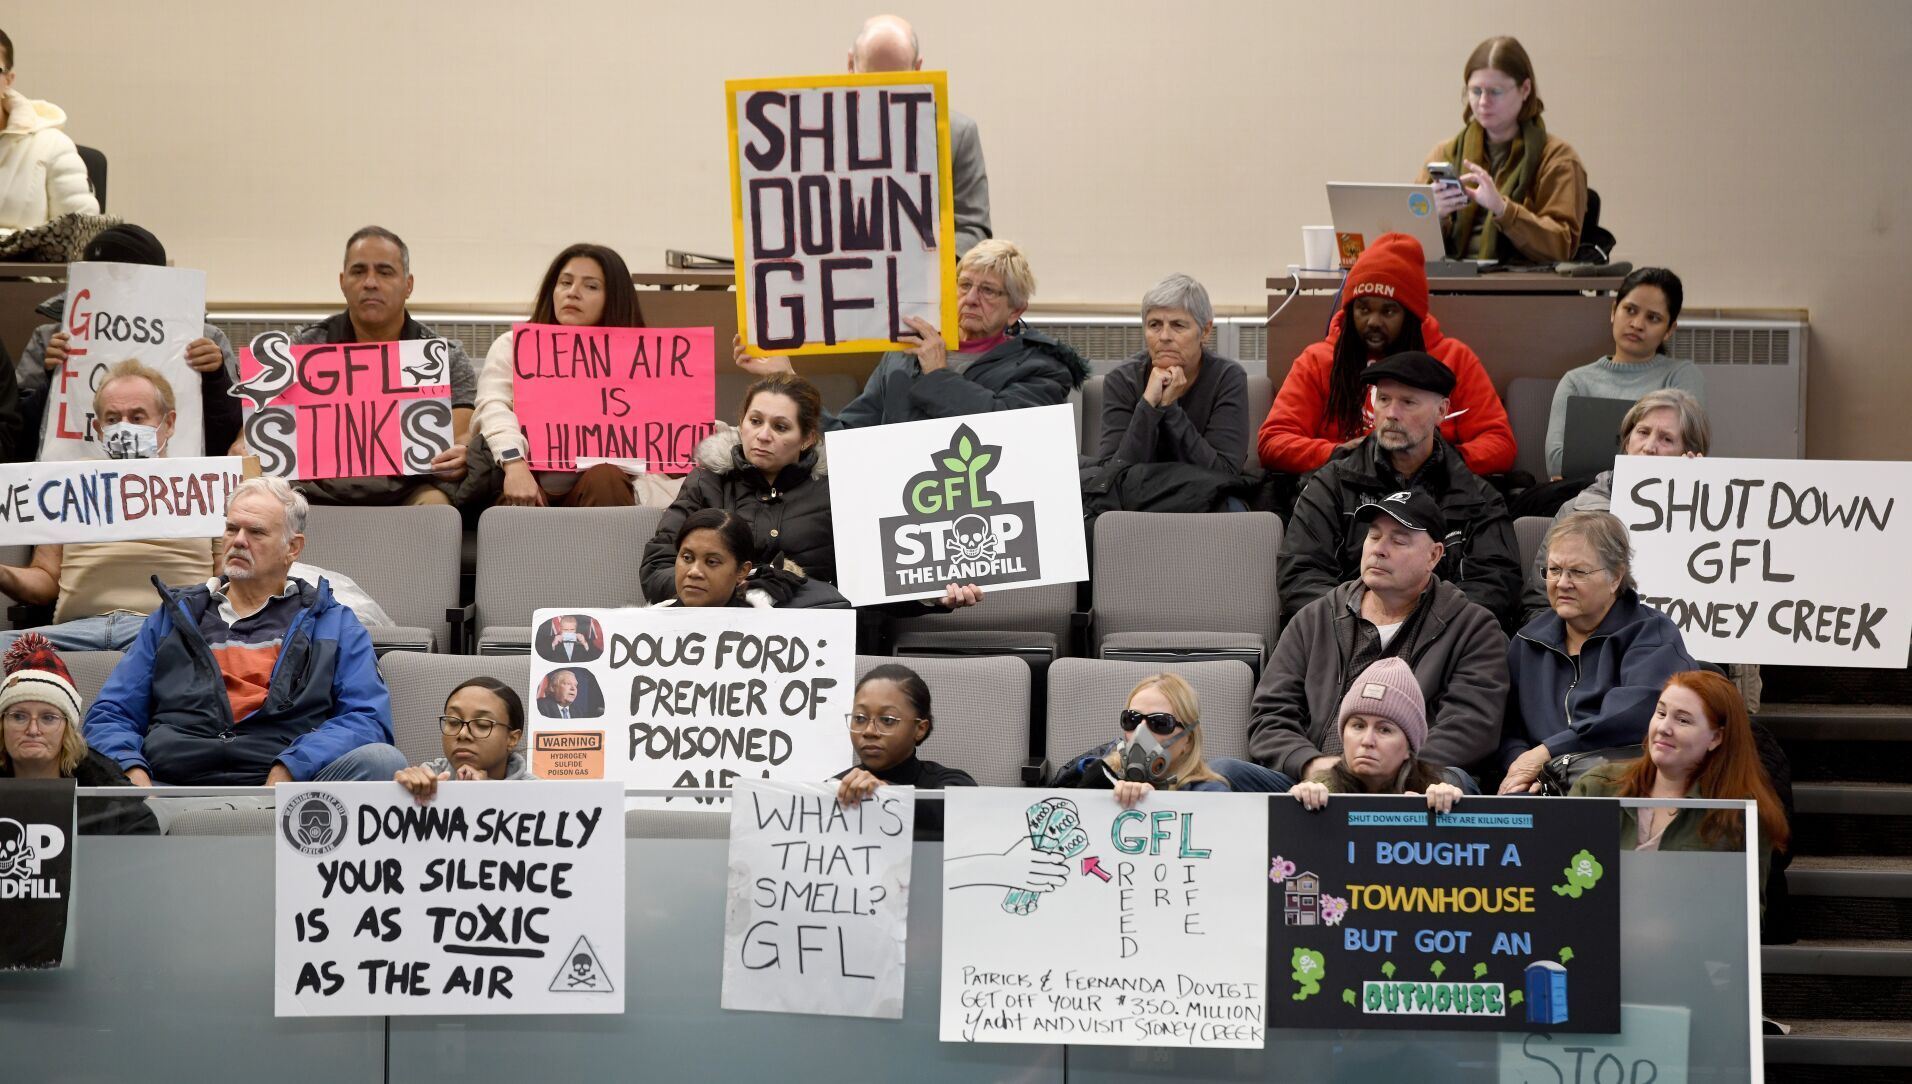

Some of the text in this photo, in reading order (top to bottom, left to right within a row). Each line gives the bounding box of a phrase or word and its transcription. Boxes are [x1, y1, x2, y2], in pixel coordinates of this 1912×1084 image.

[745, 90, 932, 173] SHUT
[750, 174, 937, 259] DOWN
[754, 256, 941, 350] GFL
[1353, 282, 1395, 298] ACORN
[69, 289, 165, 345] GROSS
[514, 328, 694, 379] CLEAN AIR
[601, 387, 631, 417] IS
[244, 400, 452, 478] STINKS
[546, 423, 637, 470] HUMAN
[911, 454, 992, 514] GFL
[1629, 478, 1894, 533] SHUT DOWN
[895, 556, 1027, 586] THE LANDFILL
[1687, 538, 1795, 584] GFL
[1640, 594, 1888, 652] TONEY CREEK
[609, 630, 829, 673] DOUG FORD:
[631, 675, 837, 720] PREMIER OF
[543, 737, 596, 747] WARNING
[629, 722, 793, 766] POISONED
[284, 792, 313, 816] WARNING
[752, 791, 903, 836] WHAT'S
[1348, 815, 1370, 823] SHUT
[1374, 815, 1400, 823] DOWN
[1436, 816, 1457, 824] THEY
[1478, 817, 1509, 825] KILLING
[358, 804, 602, 849] DONNA SKELLY
[1111, 808, 1212, 859] GFL
[771, 841, 881, 876] THAT
[1348, 841, 1522, 866] I BOUGHT A
[0, 878, 61, 898] DFILL
[317, 858, 573, 899] YOUR SILENCE
[754, 877, 887, 916] SMELL?
[1346, 884, 1536, 914] TOWNHOUSE
[295, 903, 550, 944] IS AS TOXIC
[1344, 927, 1532, 956] BUT GOT AN
[741, 920, 875, 980] GFL
[295, 959, 513, 999] AS THE AIR
[962, 965, 1258, 1000] PATRICK & FERNANDA DOVIGI
[1365, 983, 1503, 1014] OUTHOUSE
[961, 991, 996, 1008] GET
[1006, 993, 1035, 1008] OFF
[1049, 995, 1102, 1013] YOUR
[1186, 1002, 1262, 1023] MILLION
[1034, 1016, 1075, 1033] AND
[1079, 1016, 1134, 1033] VISIT
[1135, 1019, 1196, 1045] STONEY
[1200, 1022, 1265, 1042] CREEK
[1523, 1032, 1657, 1084] STOP
